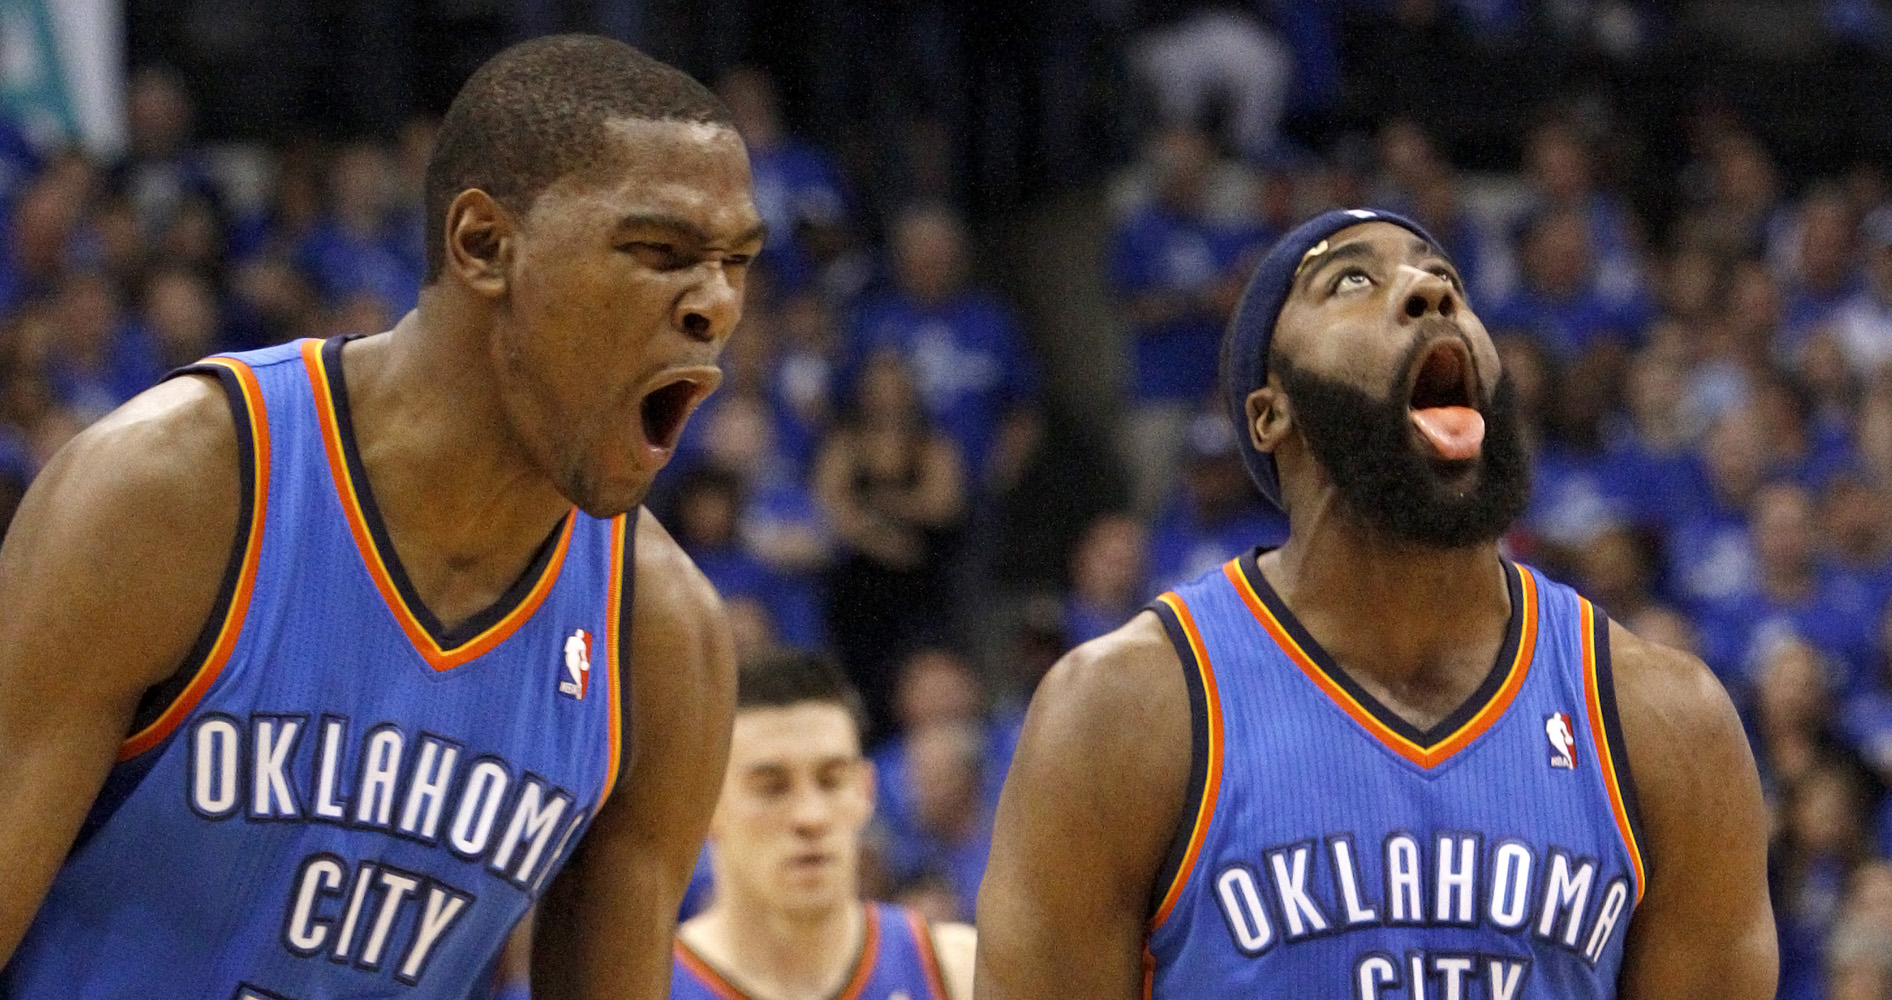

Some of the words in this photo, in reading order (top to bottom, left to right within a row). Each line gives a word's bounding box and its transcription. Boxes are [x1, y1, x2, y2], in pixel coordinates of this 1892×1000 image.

[190, 712, 586, 890] OKLAHOM
[287, 853, 474, 983] CITY
[1215, 831, 1630, 966] OKLAHOMA
